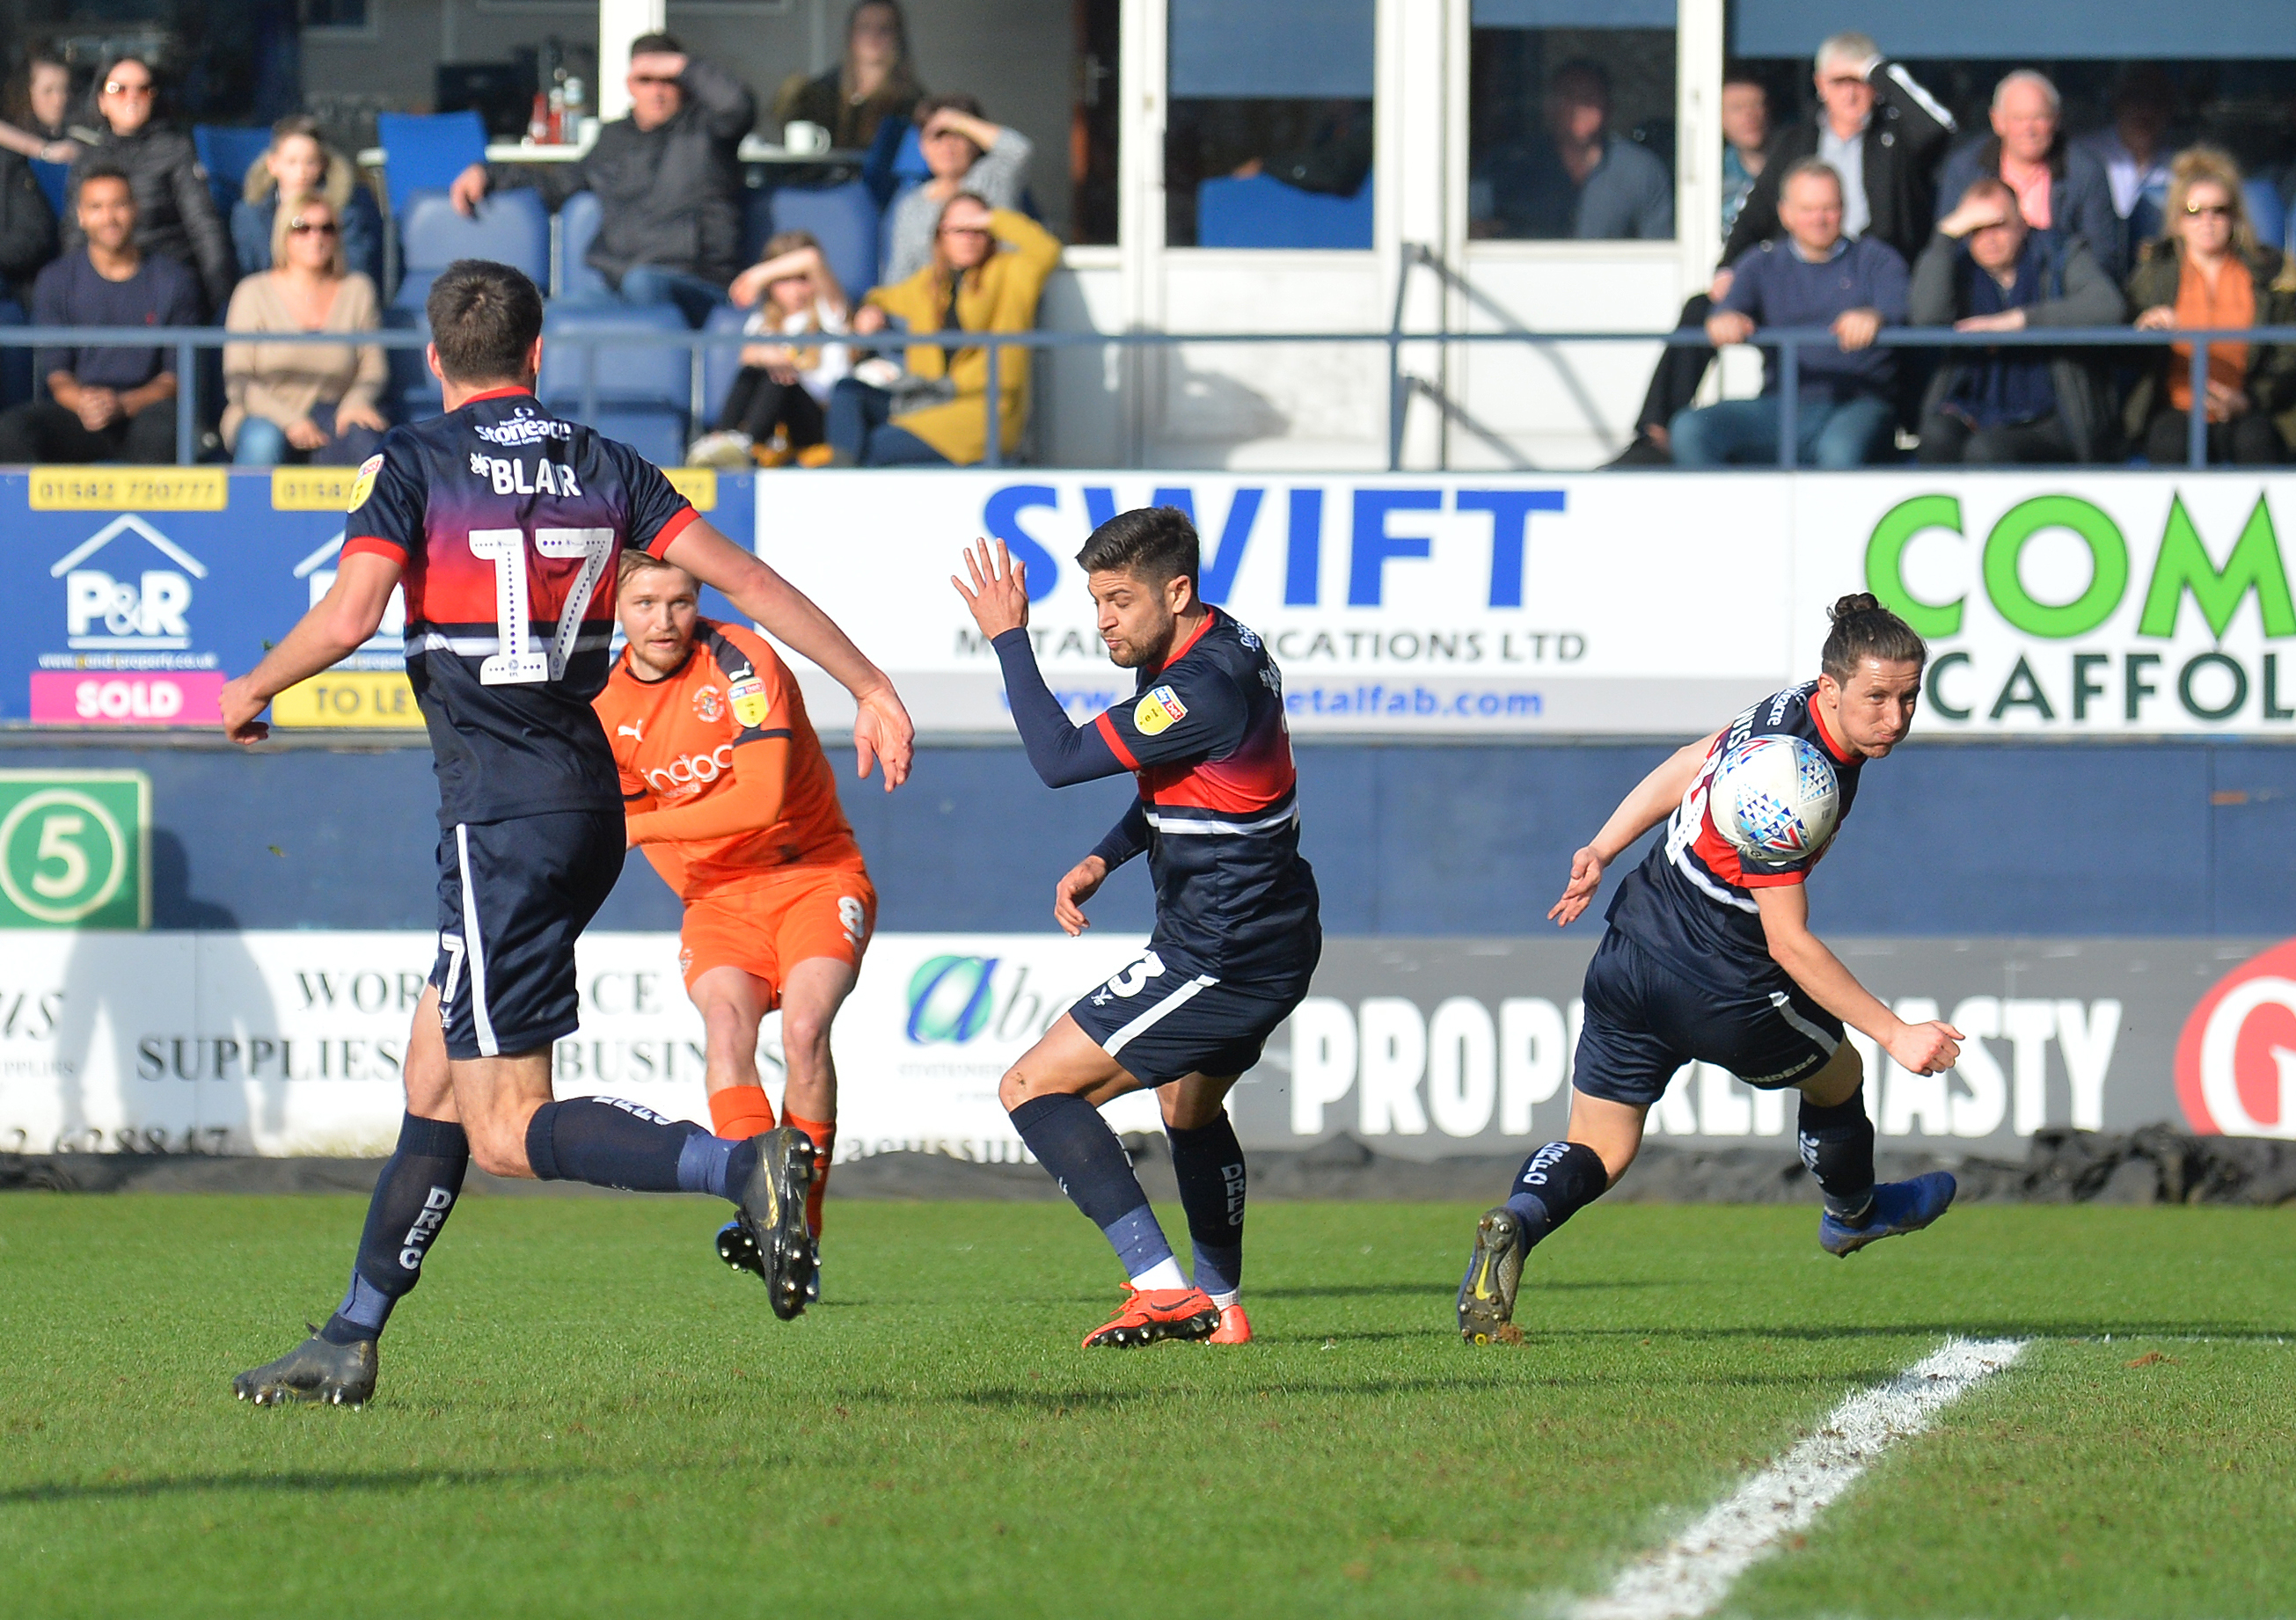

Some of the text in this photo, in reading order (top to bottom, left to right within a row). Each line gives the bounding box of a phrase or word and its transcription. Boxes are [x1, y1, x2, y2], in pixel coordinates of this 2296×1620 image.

[983, 485, 1566, 607] SWIFT
[67, 570, 193, 636] P&R
[469, 528, 615, 686] 17
[956, 629, 1112, 660] MTAL
[1261, 629, 1481, 661] ICATIONS
[1501, 631, 1586, 661] LTD
[75, 680, 183, 719] SOLD
[316, 687, 406, 715] TO LE
[1925, 652, 2296, 720] CAFFOL
[32, 814, 88, 899] 5
[837, 896, 866, 938] 8
[295, 971, 664, 1015] WORCE
[136, 1038, 787, 1083] SUPPLIES BUSINS
[1289, 997, 1786, 1136] PROPL
[1221, 1163, 1243, 1226] DRFC
[1524, 1142, 1571, 1186] DRFC
[399, 1187, 451, 1270] DRFC
